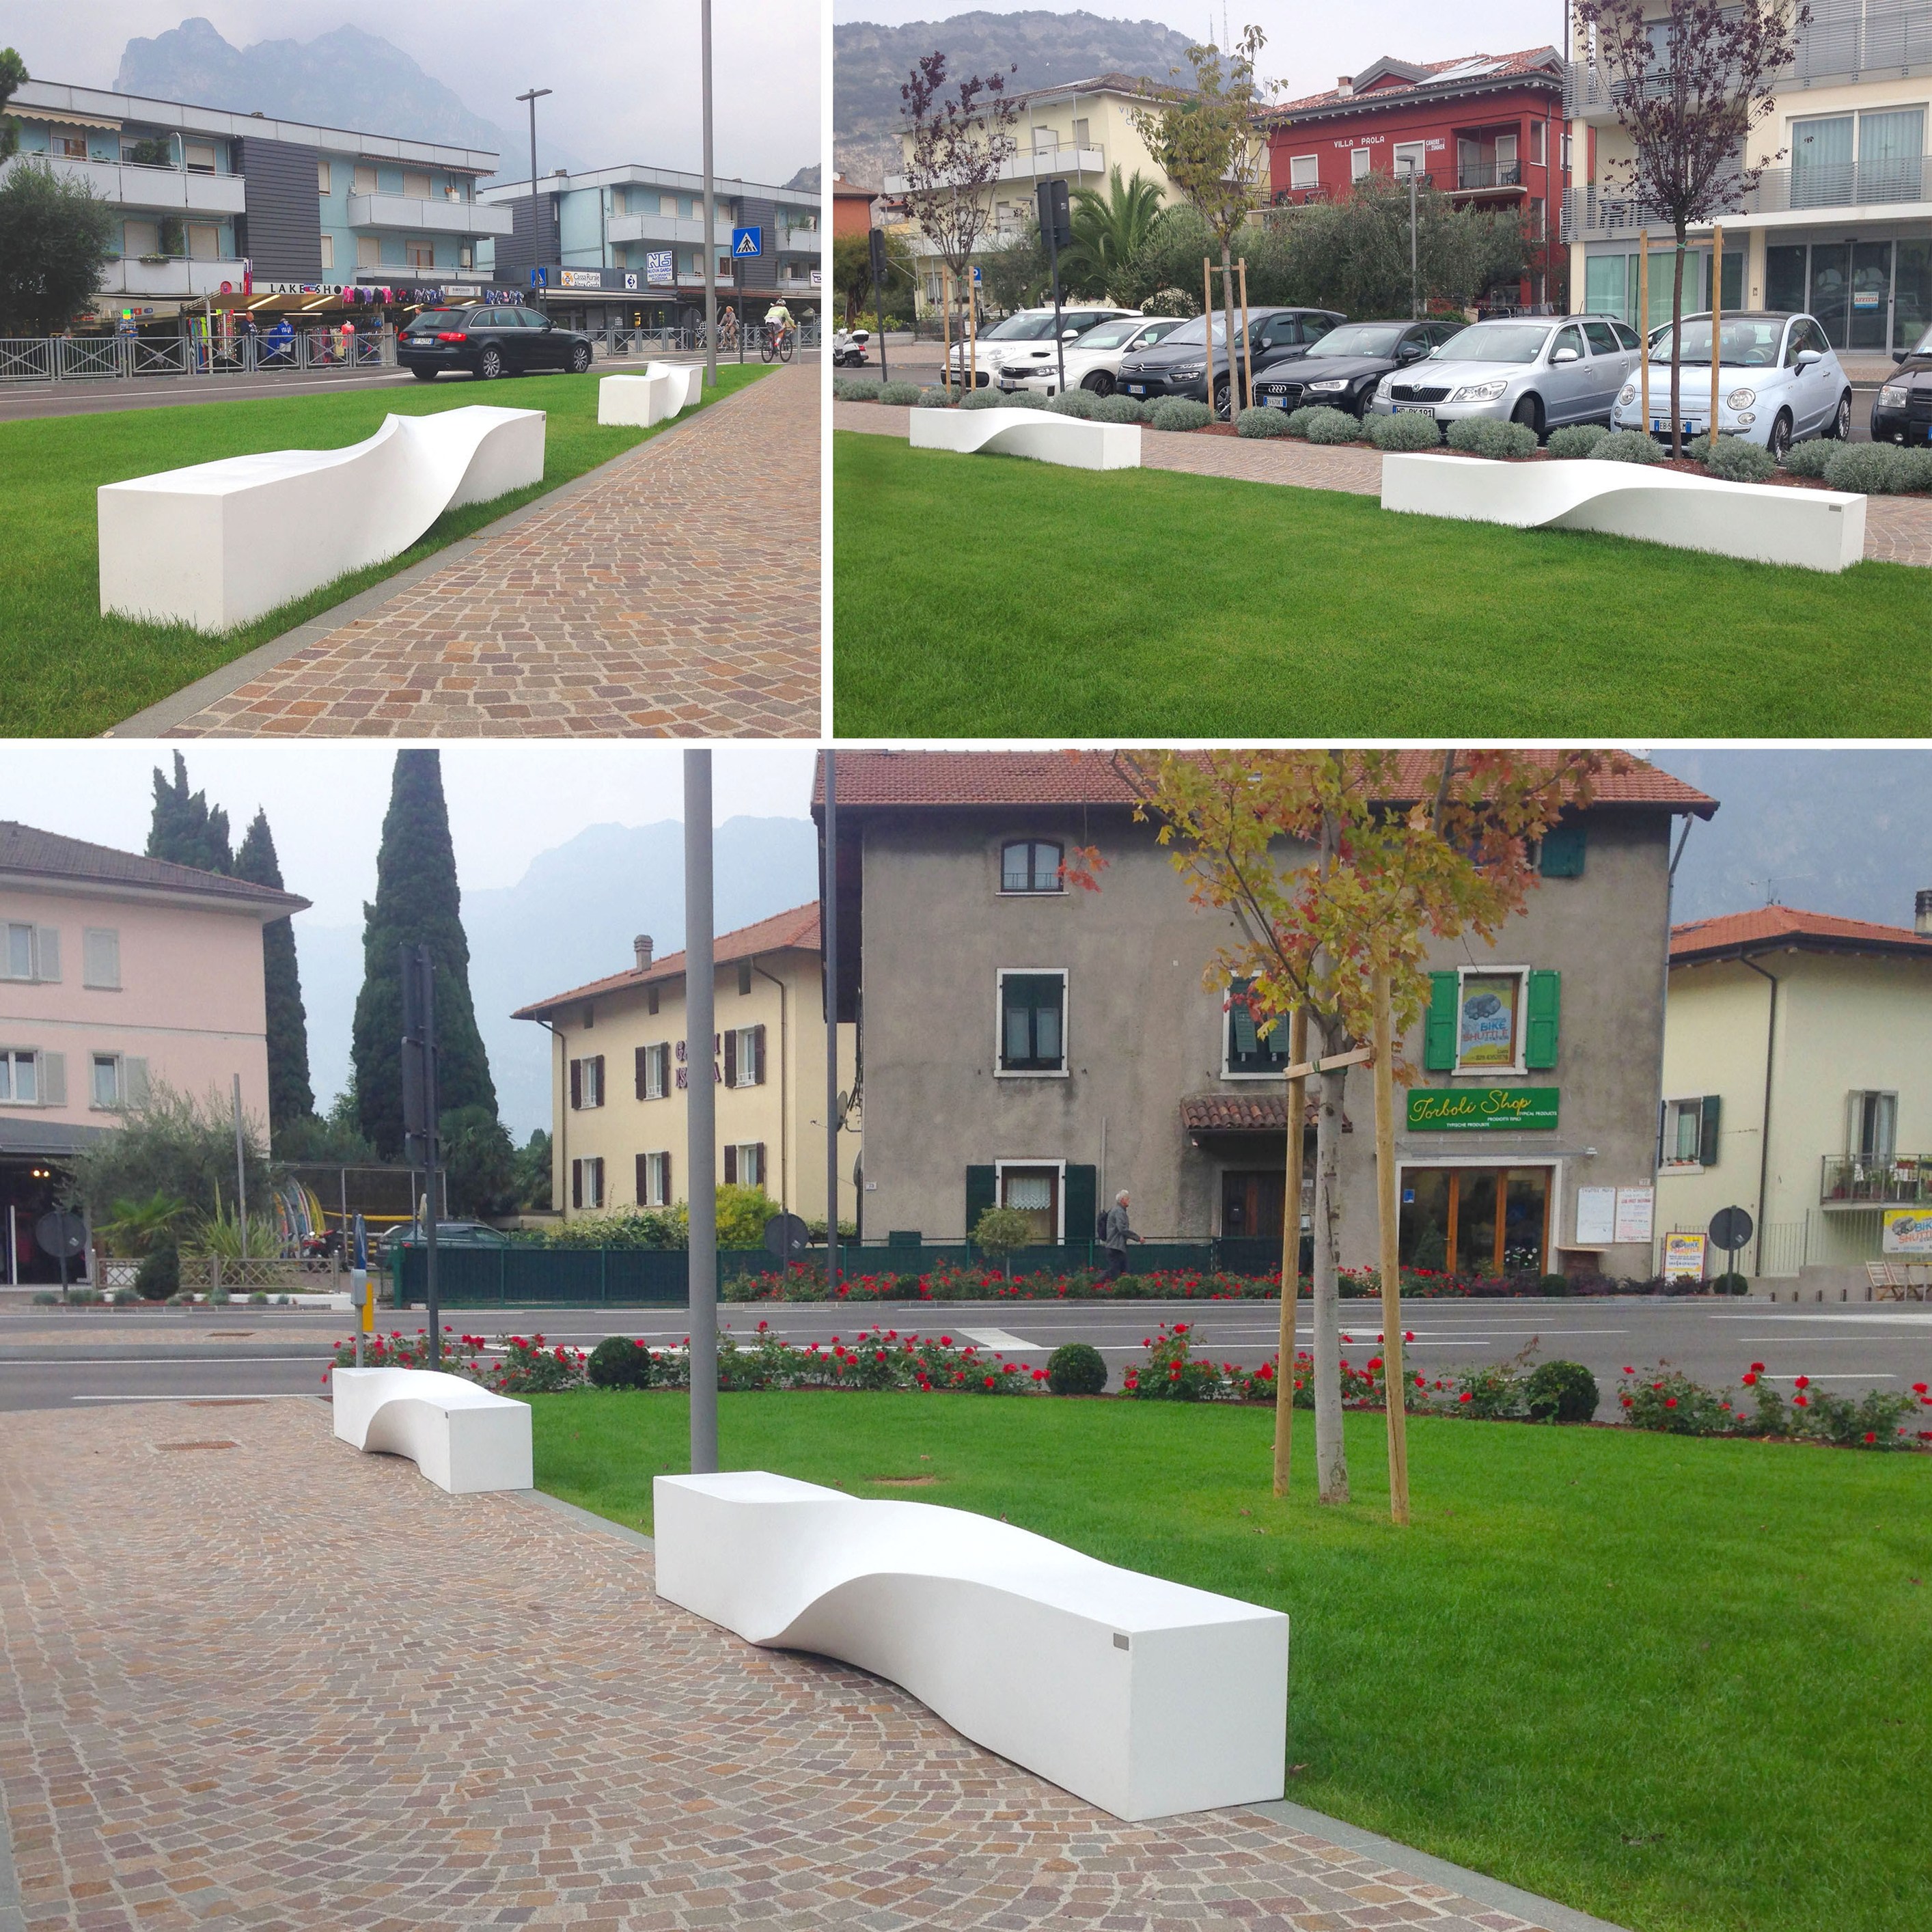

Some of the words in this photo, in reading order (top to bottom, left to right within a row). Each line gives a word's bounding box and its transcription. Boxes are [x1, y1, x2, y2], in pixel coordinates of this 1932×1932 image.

[1334, 139, 1353, 148] VILLA
[1361, 135, 1385, 145] PAOLA
[629, 277, 634, 286] 3
[270, 284, 305, 294] LAKE
[316, 284, 342, 294] SHO
[1480, 1021, 1506, 1032] BIKE
[1480, 1090, 1531, 1116] Shop
